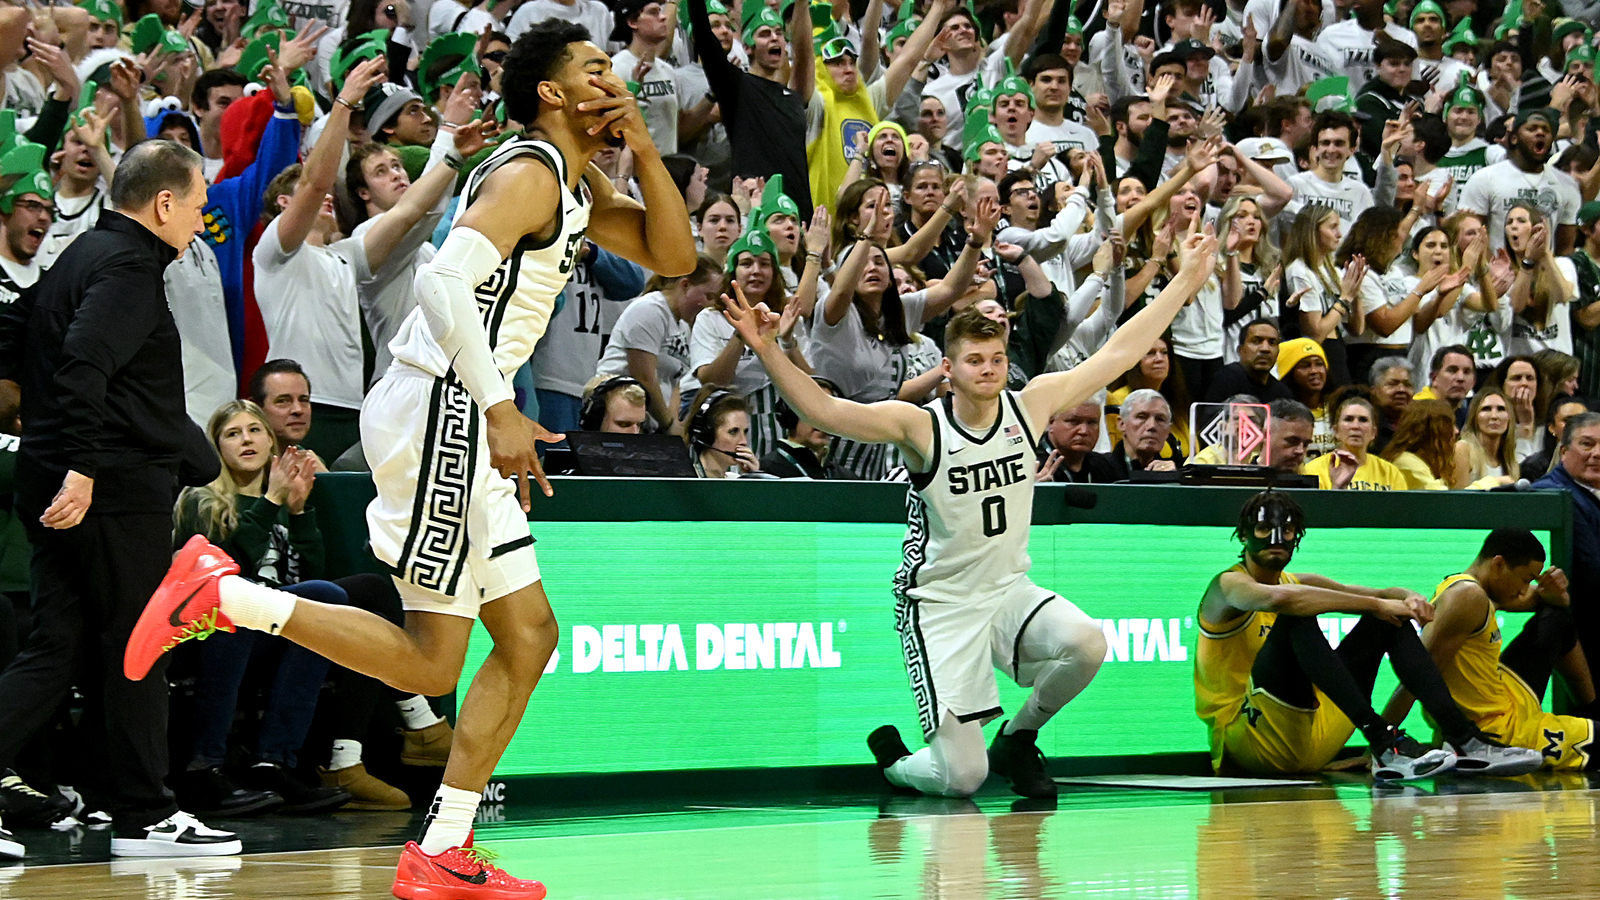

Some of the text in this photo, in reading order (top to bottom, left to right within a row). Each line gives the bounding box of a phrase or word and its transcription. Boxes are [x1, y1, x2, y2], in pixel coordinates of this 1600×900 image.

[574, 291, 600, 334] 12
[1467, 325, 1502, 359] 42
[948, 452, 1027, 495] STATE
[981, 495, 1007, 537] 0
[572, 624, 689, 673] DELTA
[1093, 618, 1187, 662] NTAL
[1541, 728, 1565, 761] M
[482, 782, 506, 801] NC
